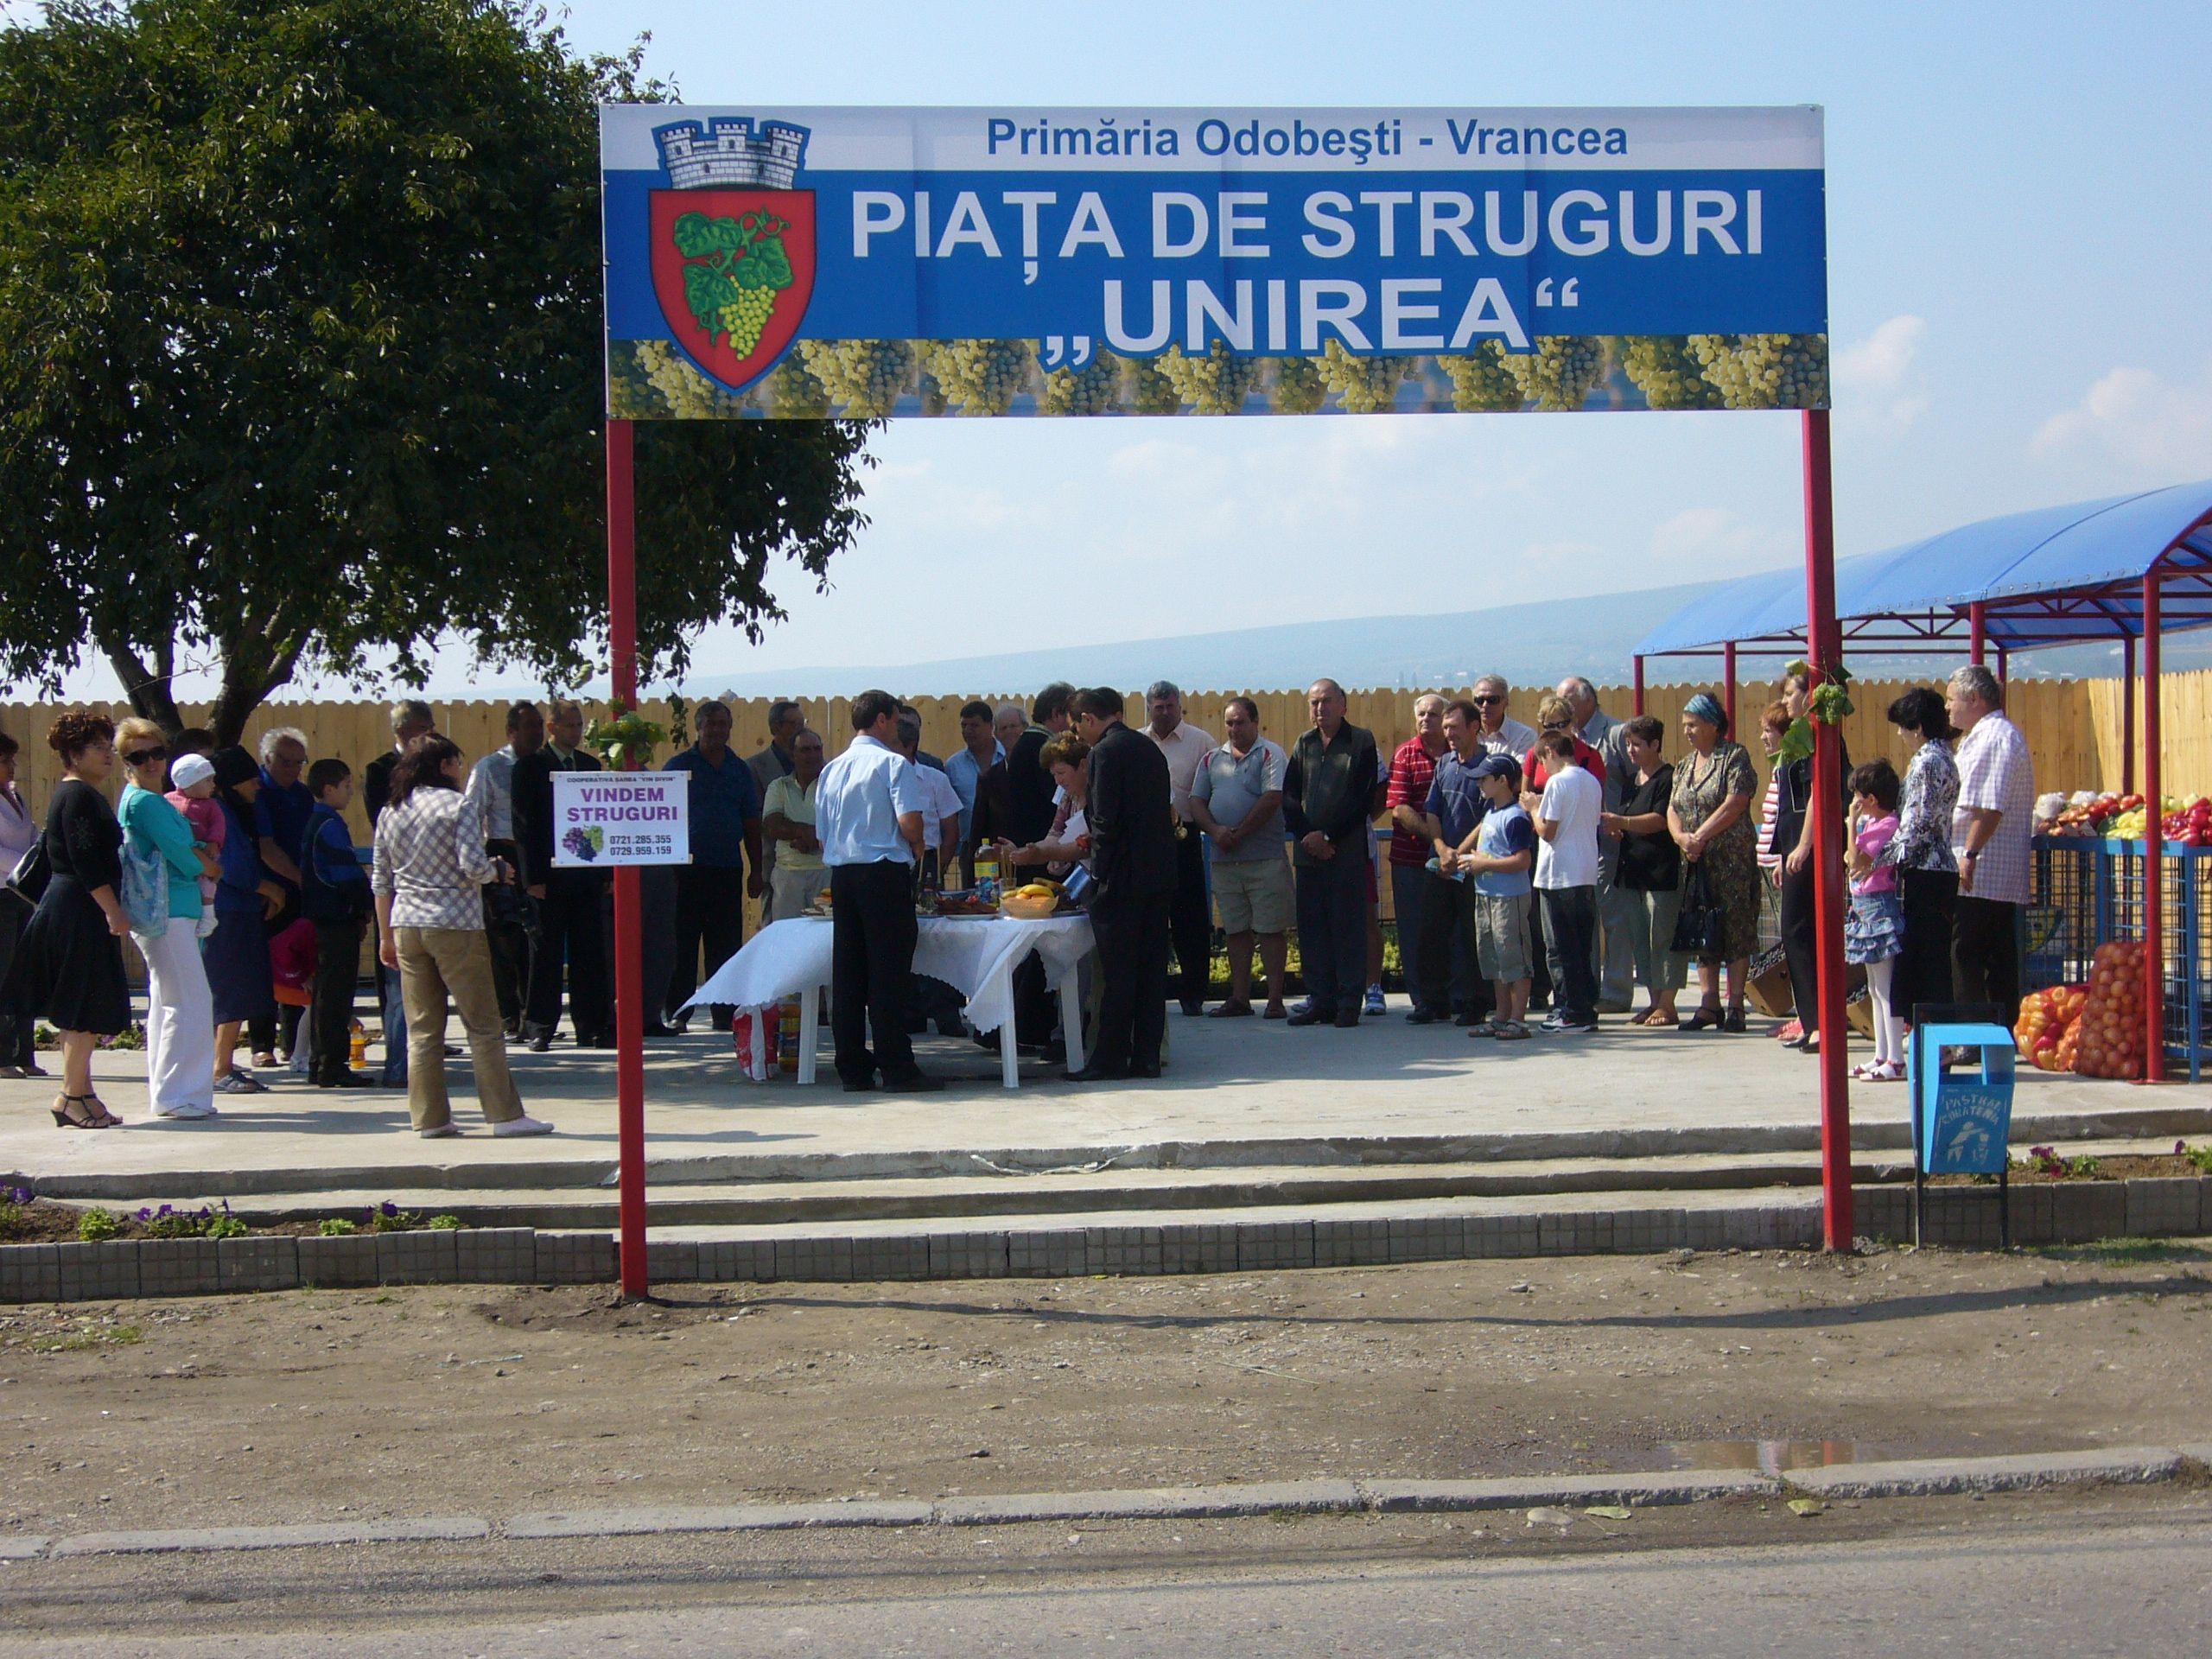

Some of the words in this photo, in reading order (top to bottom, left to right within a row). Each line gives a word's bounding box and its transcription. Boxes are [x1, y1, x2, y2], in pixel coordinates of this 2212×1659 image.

[987, 118, 1180, 156] Primăria
[1446, 118, 1628, 156] Vrancea
[1152, 191, 1270, 258] DE
[1301, 188, 1763, 259] STRUGURI
[581, 787, 664, 803] VINDEM
[567, 806, 677, 822] STRUGURI
[610, 836, 671, 844] 0721.285.355
